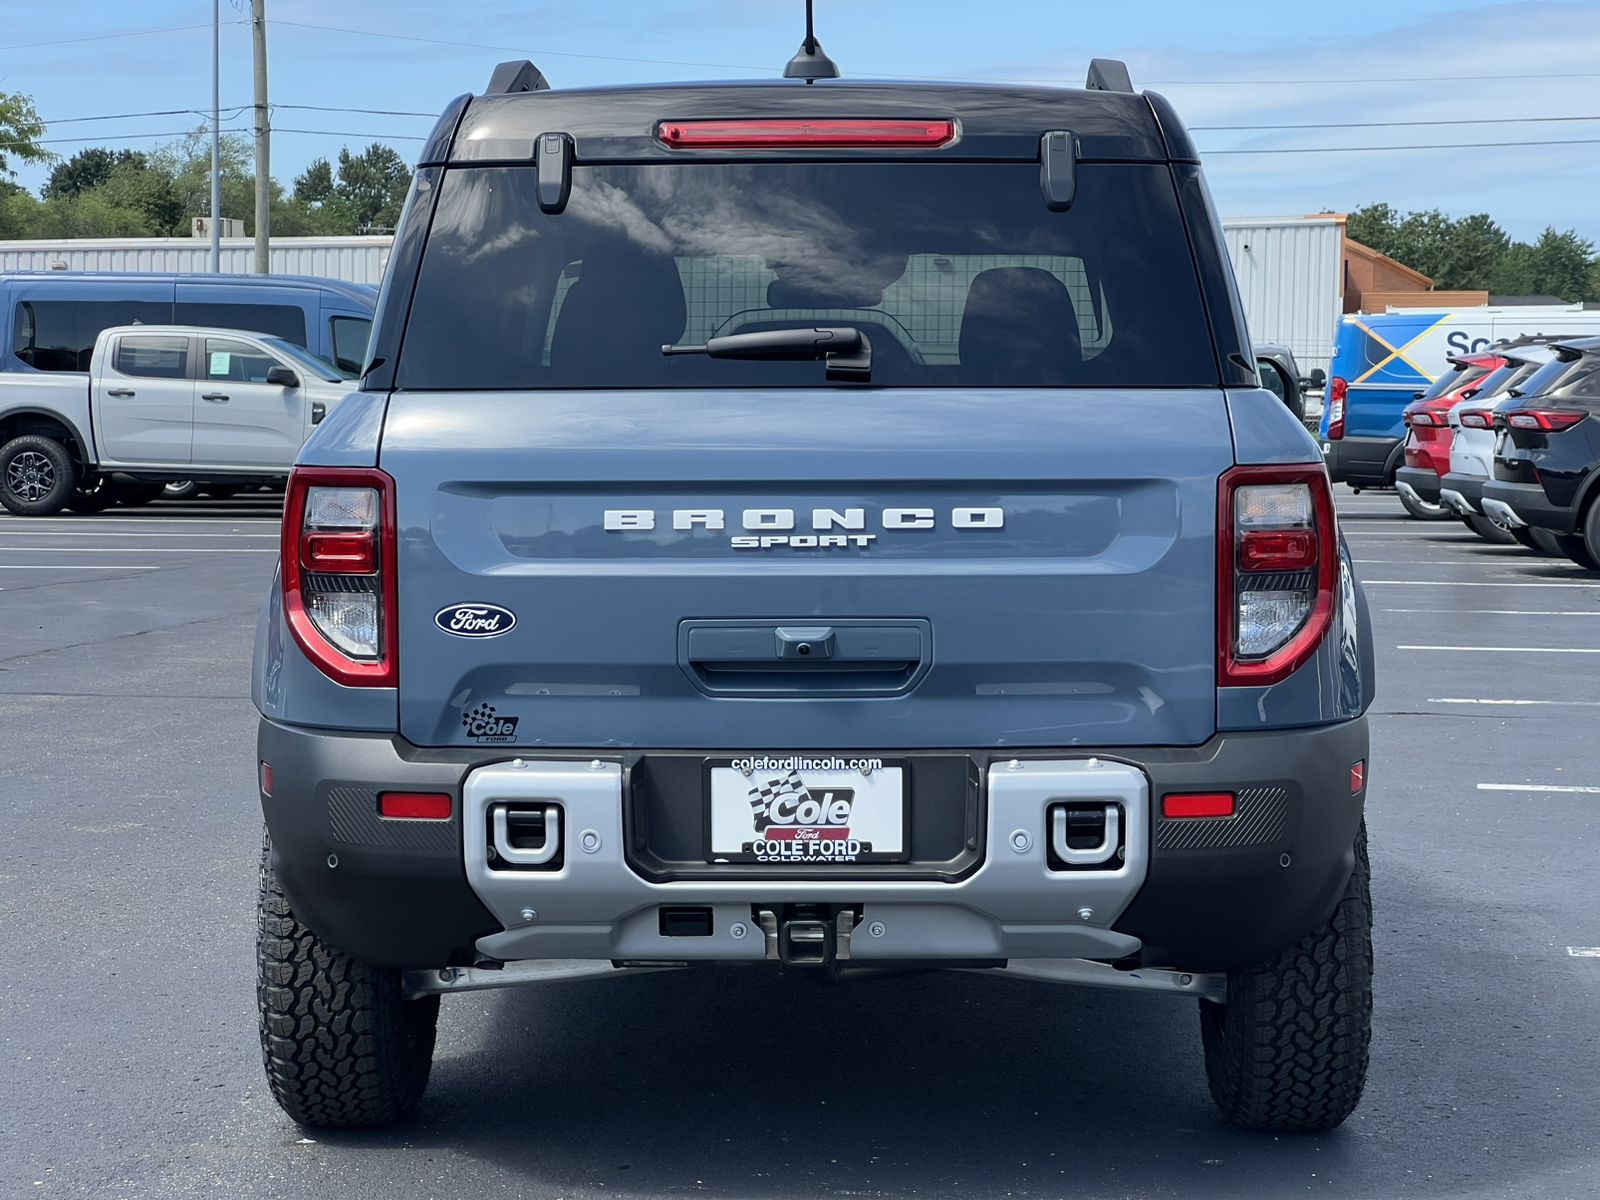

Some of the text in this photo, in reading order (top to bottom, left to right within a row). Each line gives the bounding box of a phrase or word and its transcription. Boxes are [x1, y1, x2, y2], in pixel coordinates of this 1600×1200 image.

[604, 508, 1004, 530] BRONCO
[731, 534, 876, 547] SPORT
[450, 608, 500, 631] Ford
[471, 719, 514, 735] Cole
[731, 756, 882, 770] colefordlincoln.com
[769, 792, 851, 825] Cole
[795, 828, 820, 840] Ford
[752, 839, 861, 856] COLE FORD
